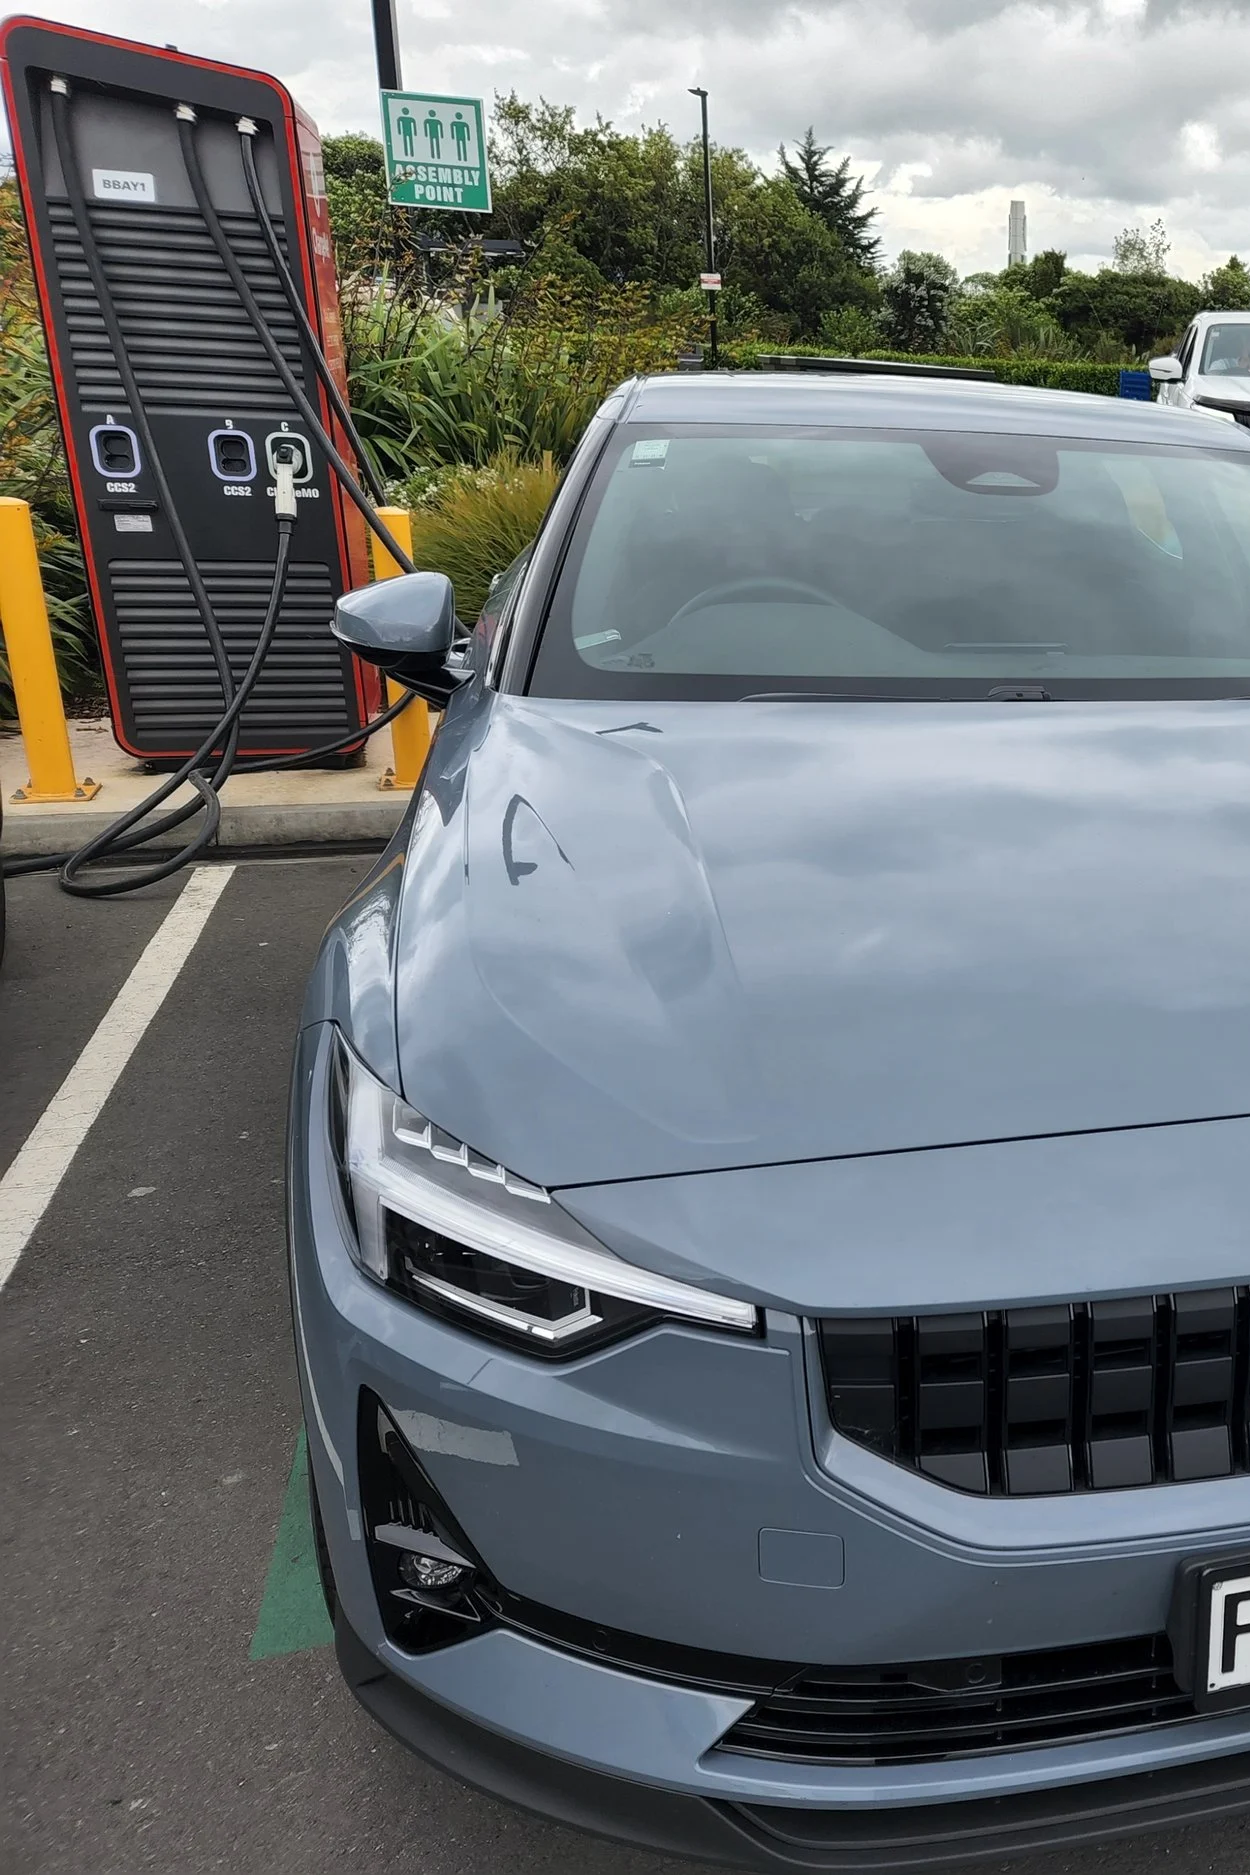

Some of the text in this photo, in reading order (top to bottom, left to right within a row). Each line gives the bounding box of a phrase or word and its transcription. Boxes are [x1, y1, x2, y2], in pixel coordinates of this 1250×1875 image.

[395, 164, 480, 186] ASSEMBLY
[102, 179, 146, 192] BBAY1
[414, 184, 464, 203] POINT
[106, 415, 115, 425] A
[225, 419, 233, 429] B
[281, 422, 289, 431] C
[107, 482, 136, 493] CCS2
[224, 485, 252, 496] CCS2
